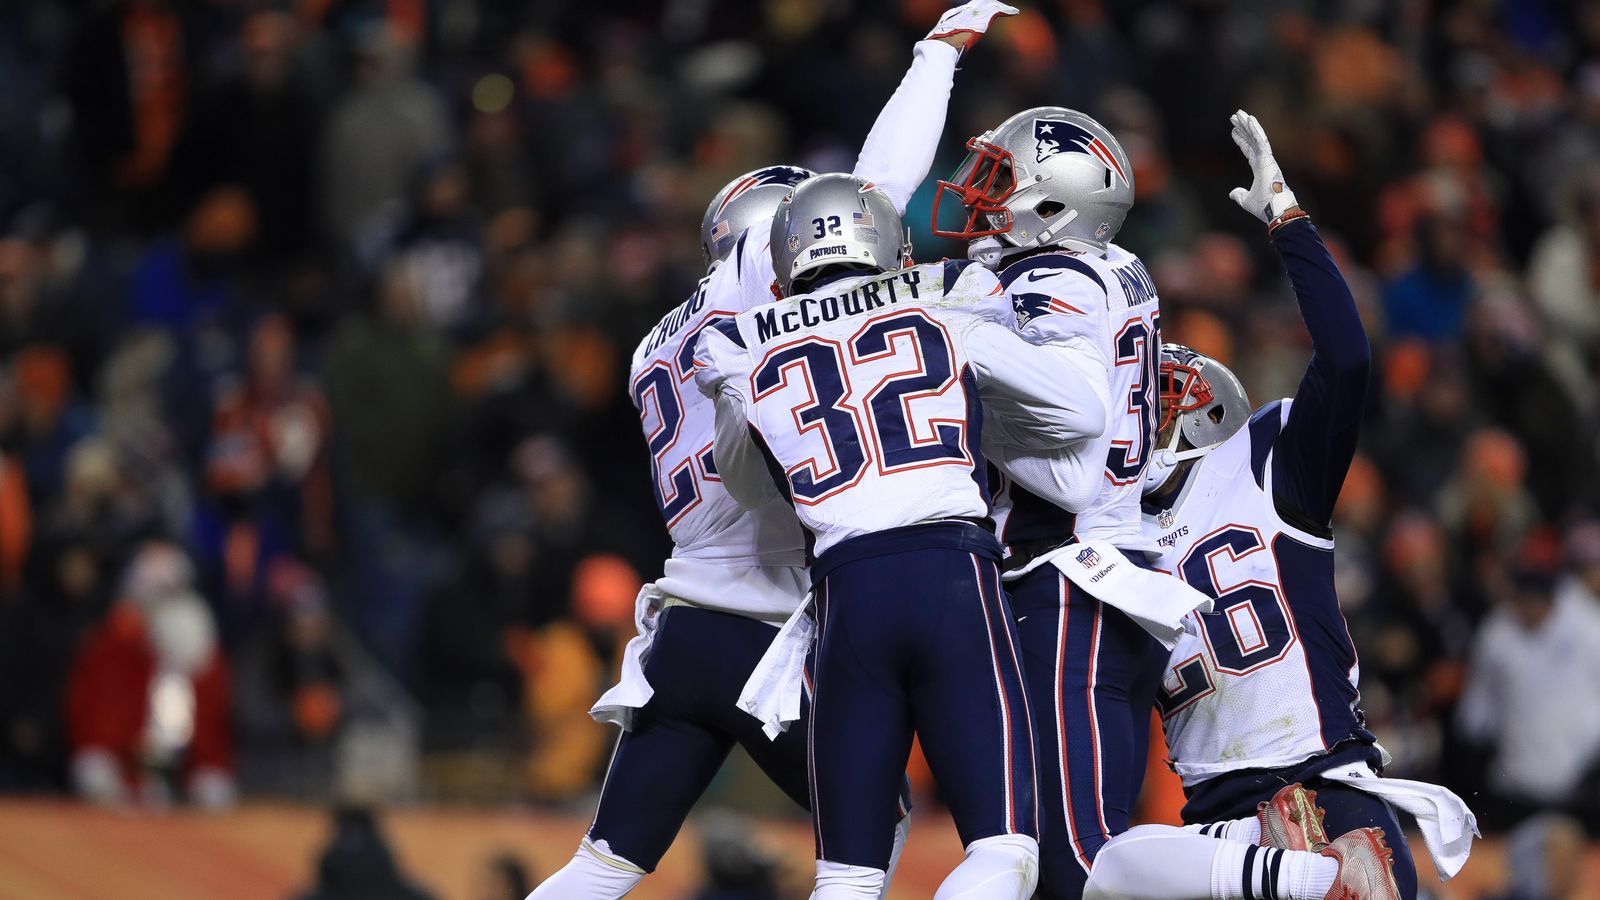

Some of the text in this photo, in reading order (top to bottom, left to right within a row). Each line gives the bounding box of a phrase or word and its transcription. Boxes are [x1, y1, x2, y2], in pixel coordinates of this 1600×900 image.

[812, 215, 842, 239] 32
[809, 245, 847, 260] PATRIOTS
[644, 277, 710, 359] CHUNG
[750, 308, 973, 506] 32
[1156, 525, 1189, 547] TRIOTS
